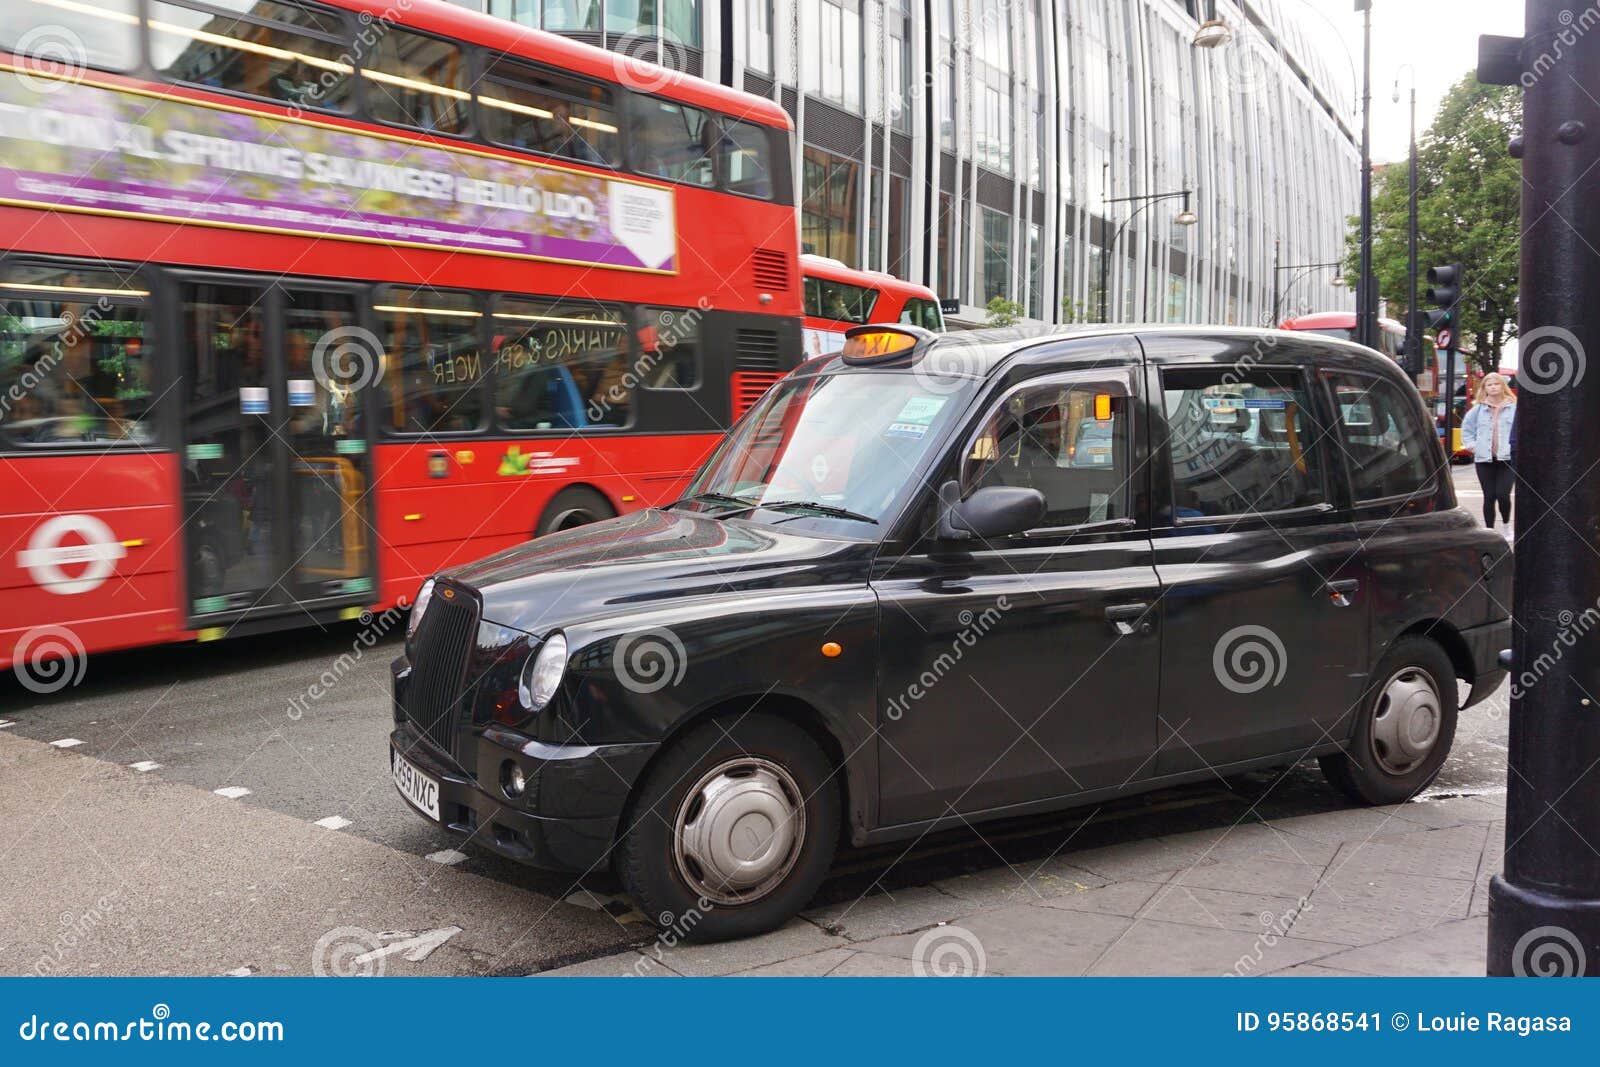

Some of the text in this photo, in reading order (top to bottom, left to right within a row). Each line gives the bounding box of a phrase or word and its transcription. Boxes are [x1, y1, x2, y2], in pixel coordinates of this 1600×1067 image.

[163, 129, 304, 180] SPRING
[455, 176, 541, 213] HELLO
[413, 771, 435, 811] NXC
